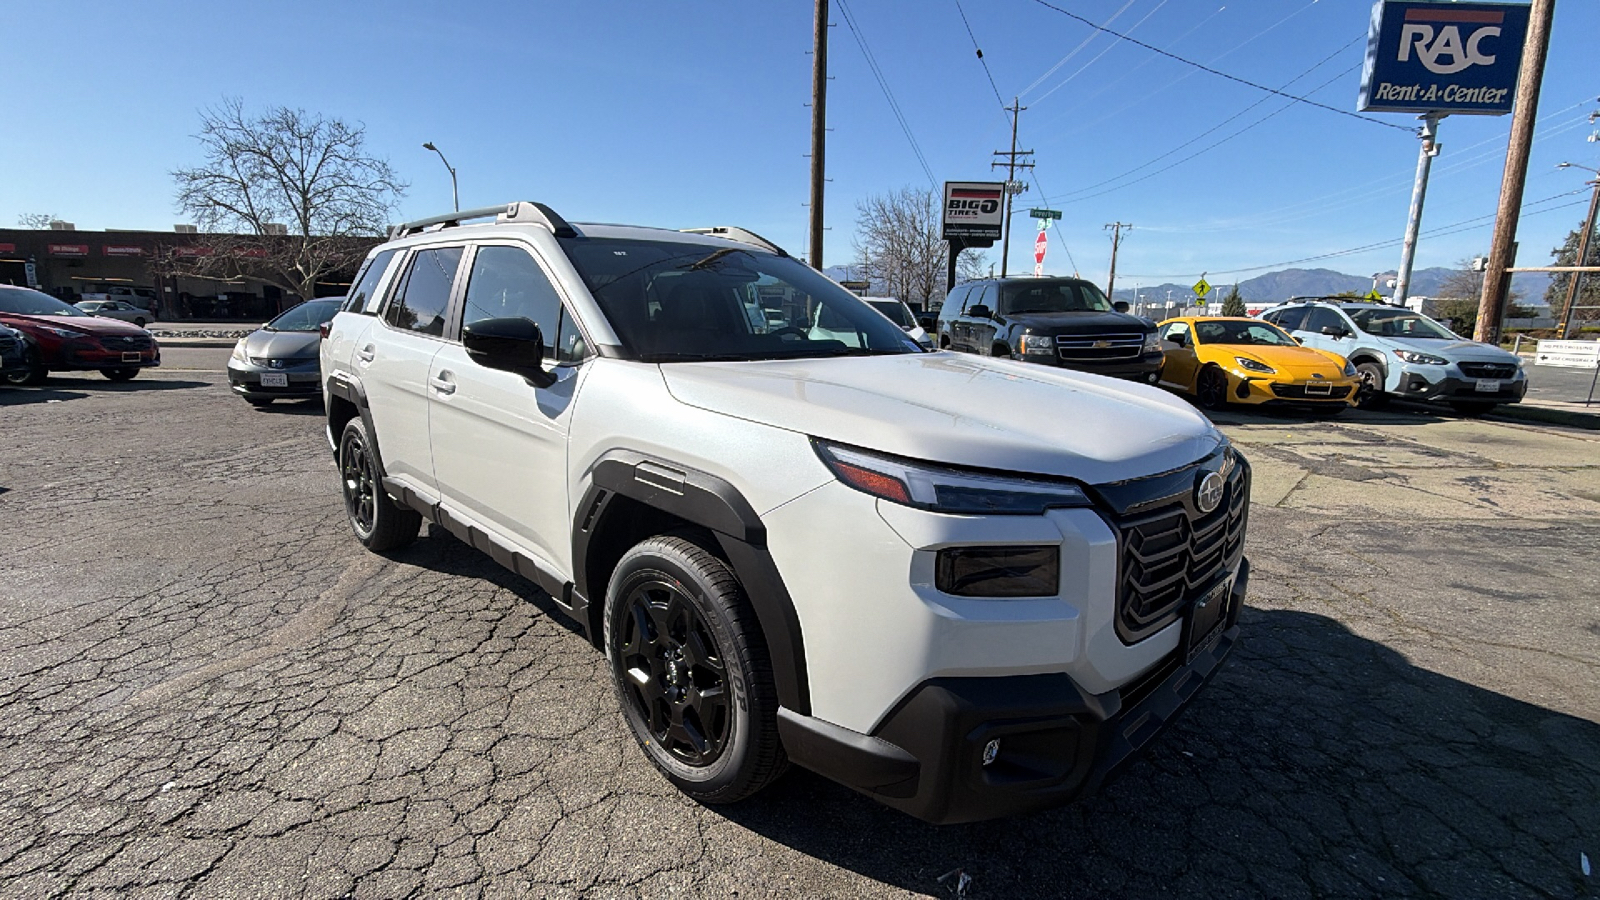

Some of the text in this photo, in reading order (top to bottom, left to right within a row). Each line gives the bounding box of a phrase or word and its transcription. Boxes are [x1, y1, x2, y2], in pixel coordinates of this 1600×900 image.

[1397, 23, 1502, 75] RAC
[948, 199, 999, 214] BIG O
[1035, 241, 1047, 255] STOP
